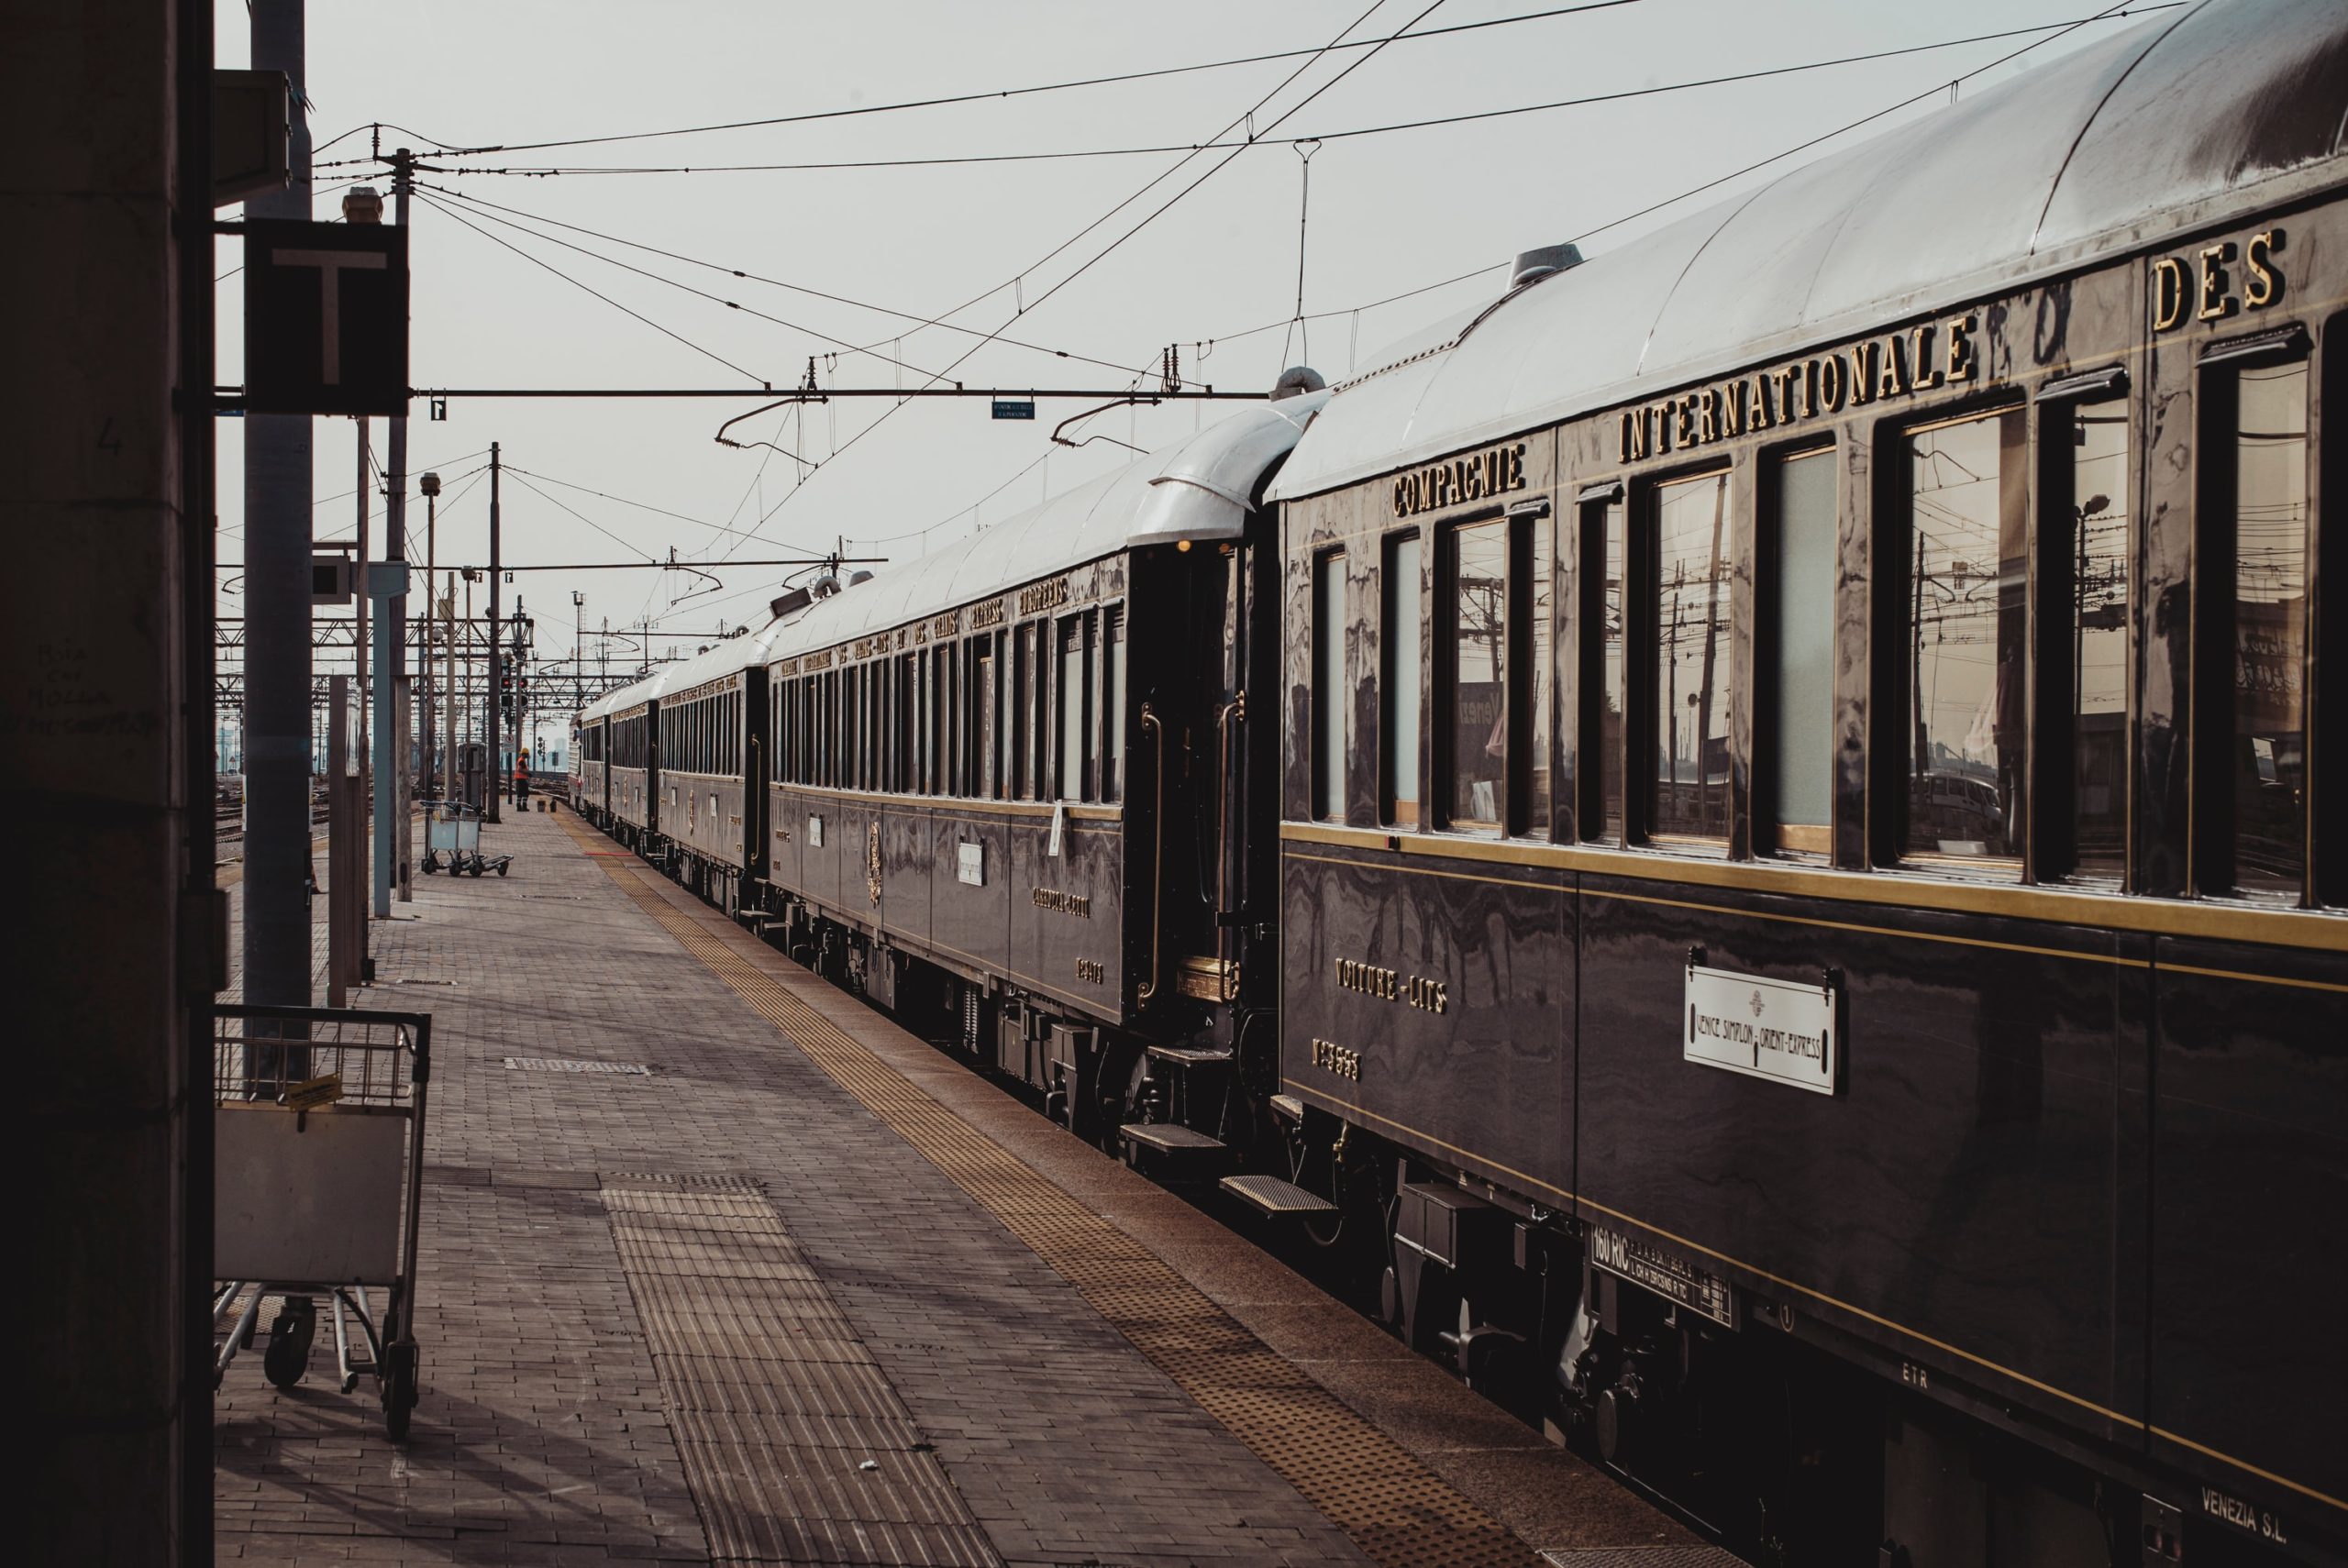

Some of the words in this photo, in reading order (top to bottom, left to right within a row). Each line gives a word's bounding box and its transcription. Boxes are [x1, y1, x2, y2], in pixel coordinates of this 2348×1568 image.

[271, 248, 387, 385] T
[1393, 445, 1520, 516] COMPAGNIE
[1617, 317, 1972, 464] INTERNATIONALE
[2154, 230, 2273, 331] DES
[1335, 957, 1448, 1014] VOITURE-LITS
[1722, 1020, 1754, 1046] SIMPLON
[1594, 1226, 1610, 1263] 160
[1611, 1232, 1629, 1272] RIC
[2202, 1486, 2256, 1531] VENEZIA
[2262, 1513, 2287, 1544] S.L.
